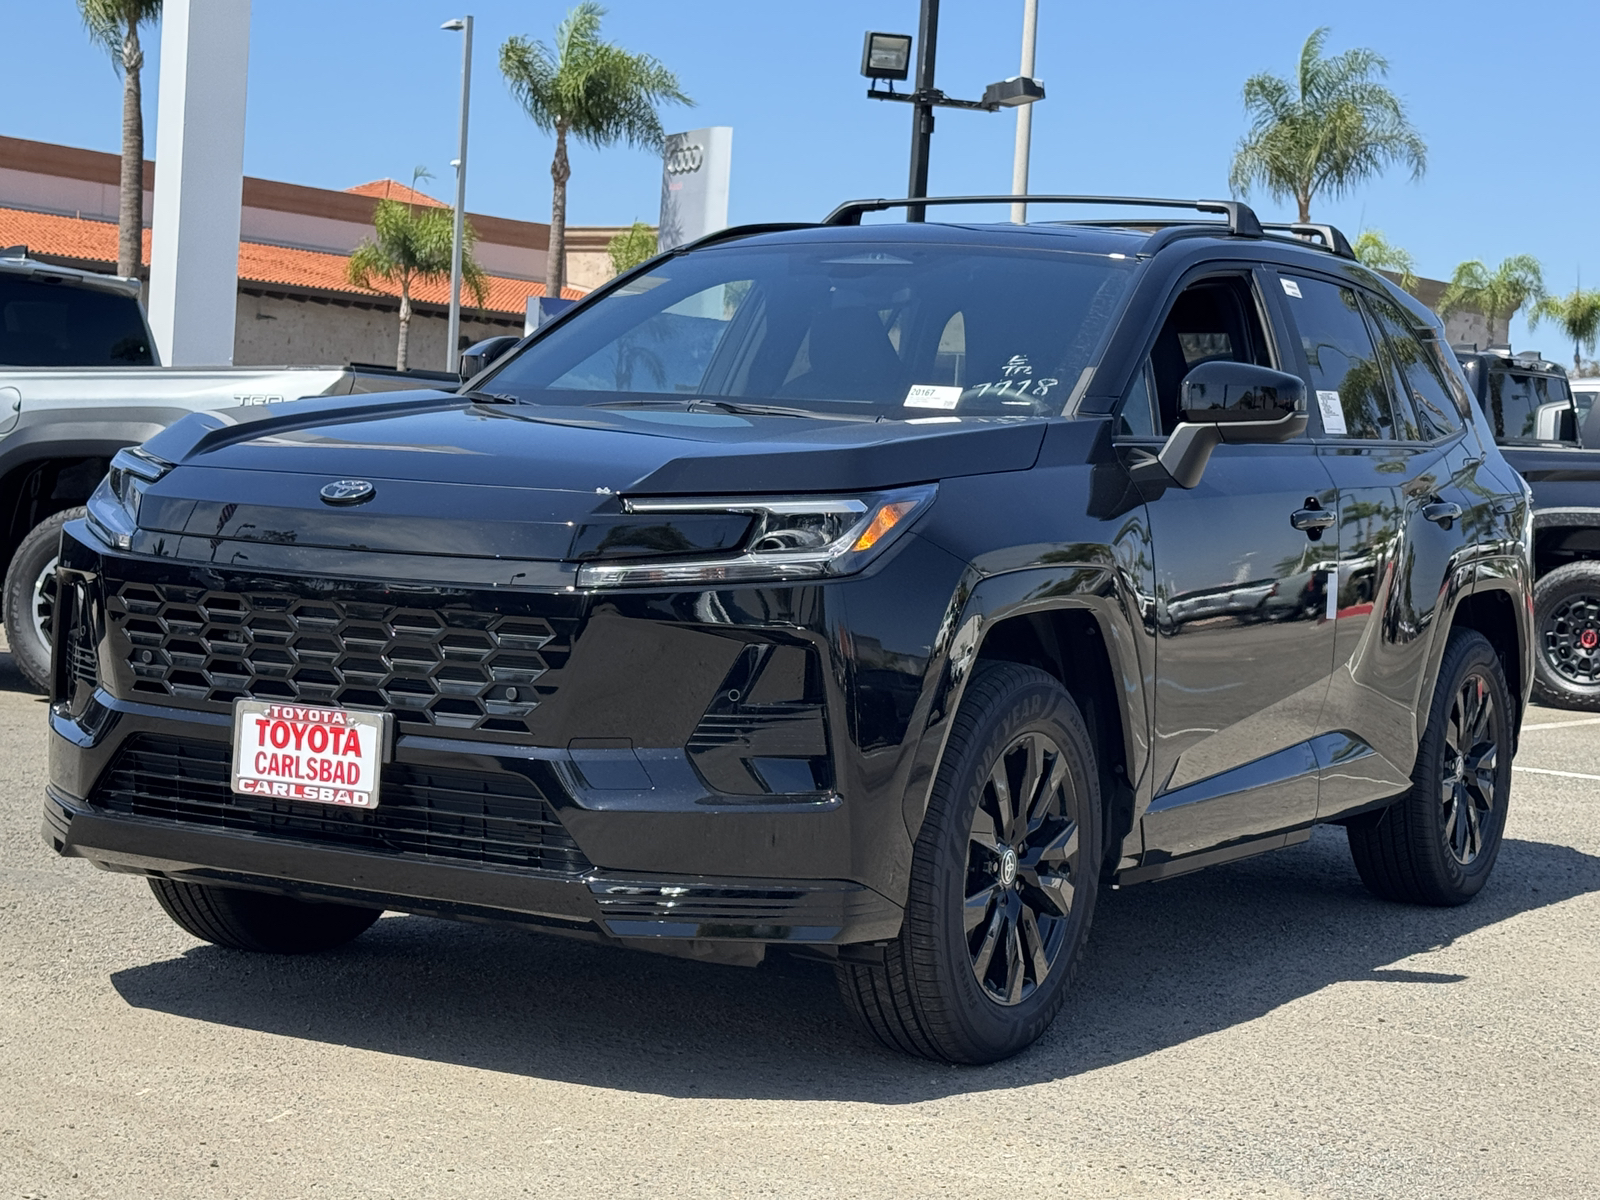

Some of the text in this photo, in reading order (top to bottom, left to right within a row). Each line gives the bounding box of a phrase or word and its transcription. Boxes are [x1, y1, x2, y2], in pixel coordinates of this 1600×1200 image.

[233, 394, 285, 407] TRD
[910, 388, 936, 397] 20167
[270, 705, 346, 725] TOYOTA
[255, 718, 363, 758] TOYOTA
[254, 751, 361, 786] CARLSBAD
[961, 693, 1042, 831] GOODYEAR
[238, 778, 370, 807] CARLSBAD
